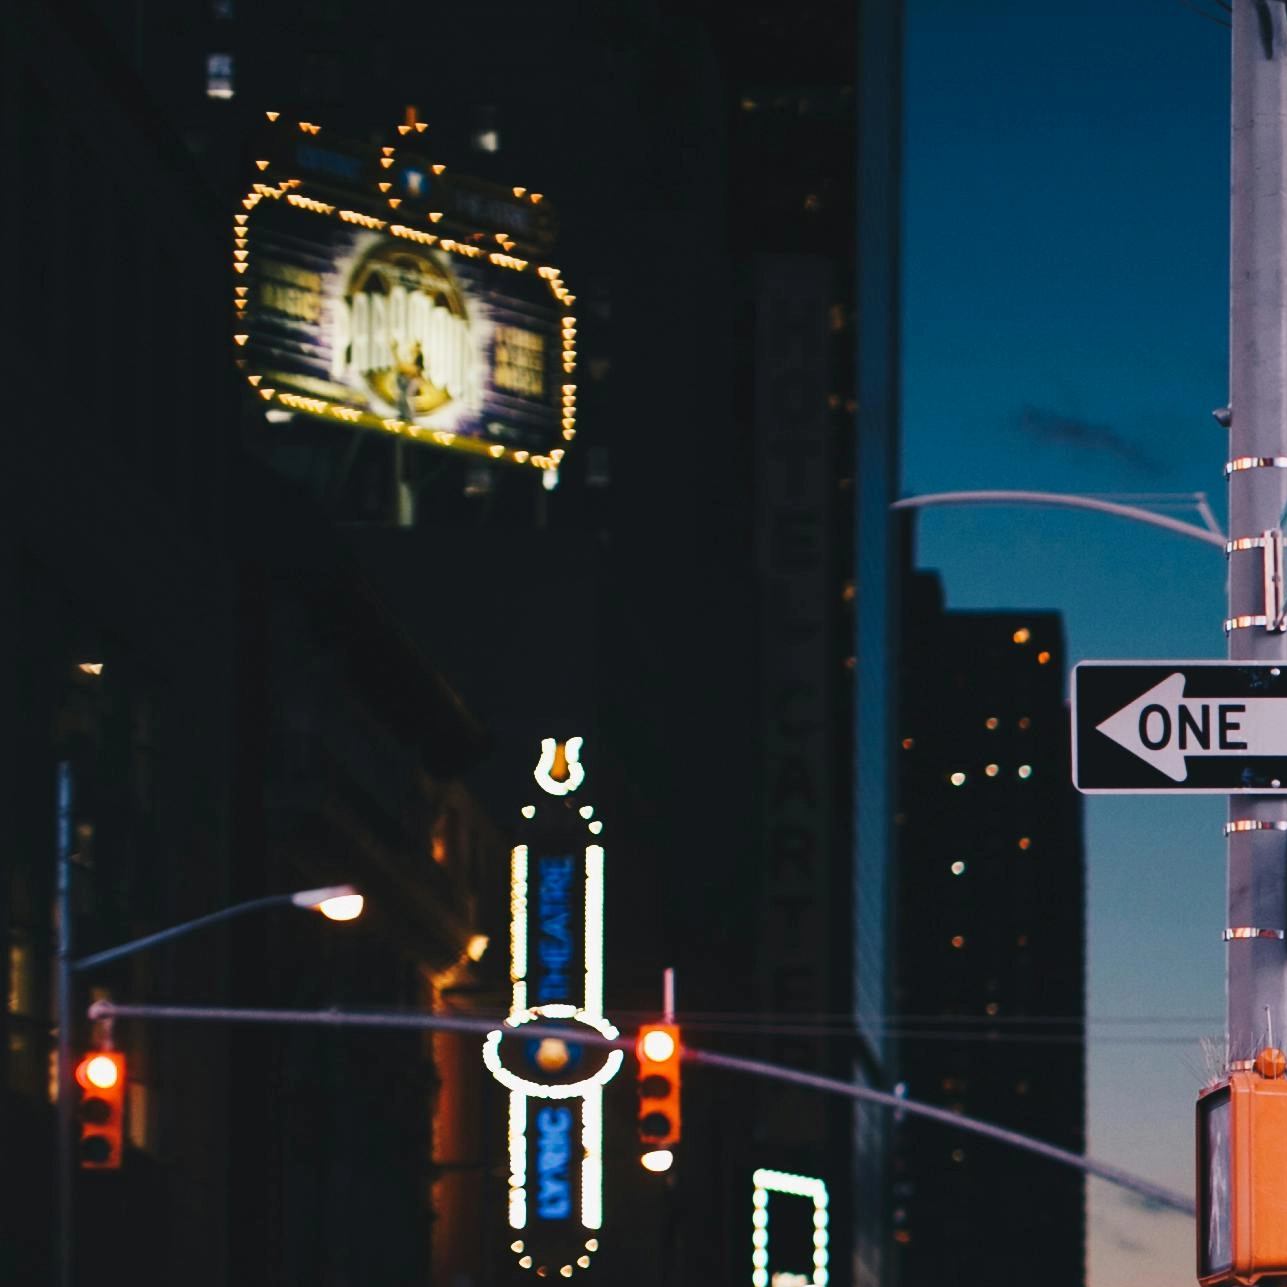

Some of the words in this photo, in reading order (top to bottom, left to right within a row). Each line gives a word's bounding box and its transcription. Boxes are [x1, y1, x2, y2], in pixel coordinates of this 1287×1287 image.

[1138, 704, 1248, 751] ONE
[539, 856, 573, 1001] THEATRE
[537, 1106, 572, 1220] LYRIC
